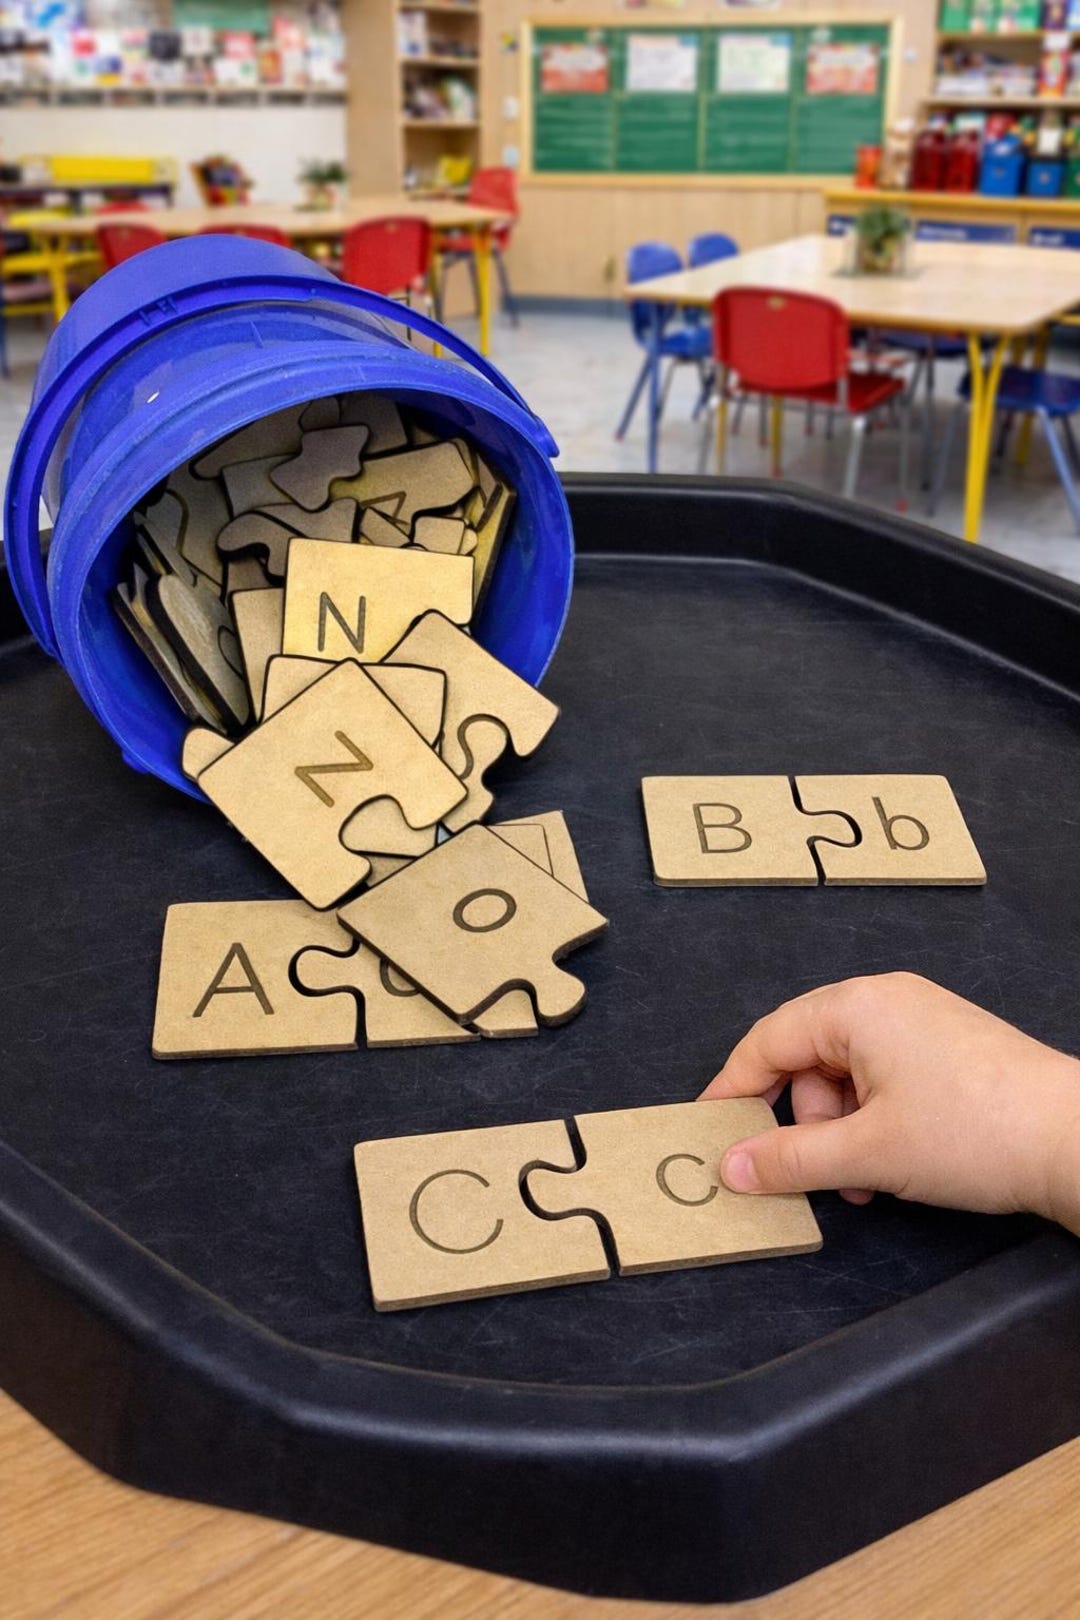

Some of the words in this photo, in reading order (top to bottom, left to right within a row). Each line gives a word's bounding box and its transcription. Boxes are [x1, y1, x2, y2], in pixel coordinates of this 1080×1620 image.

[317, 592, 367, 654] N
[692, 802, 753, 854] B
[871, 796, 931, 851] b
[192, 942, 275, 1018] A
[409, 1168, 504, 1255] C
[655, 1153, 719, 1207] c
